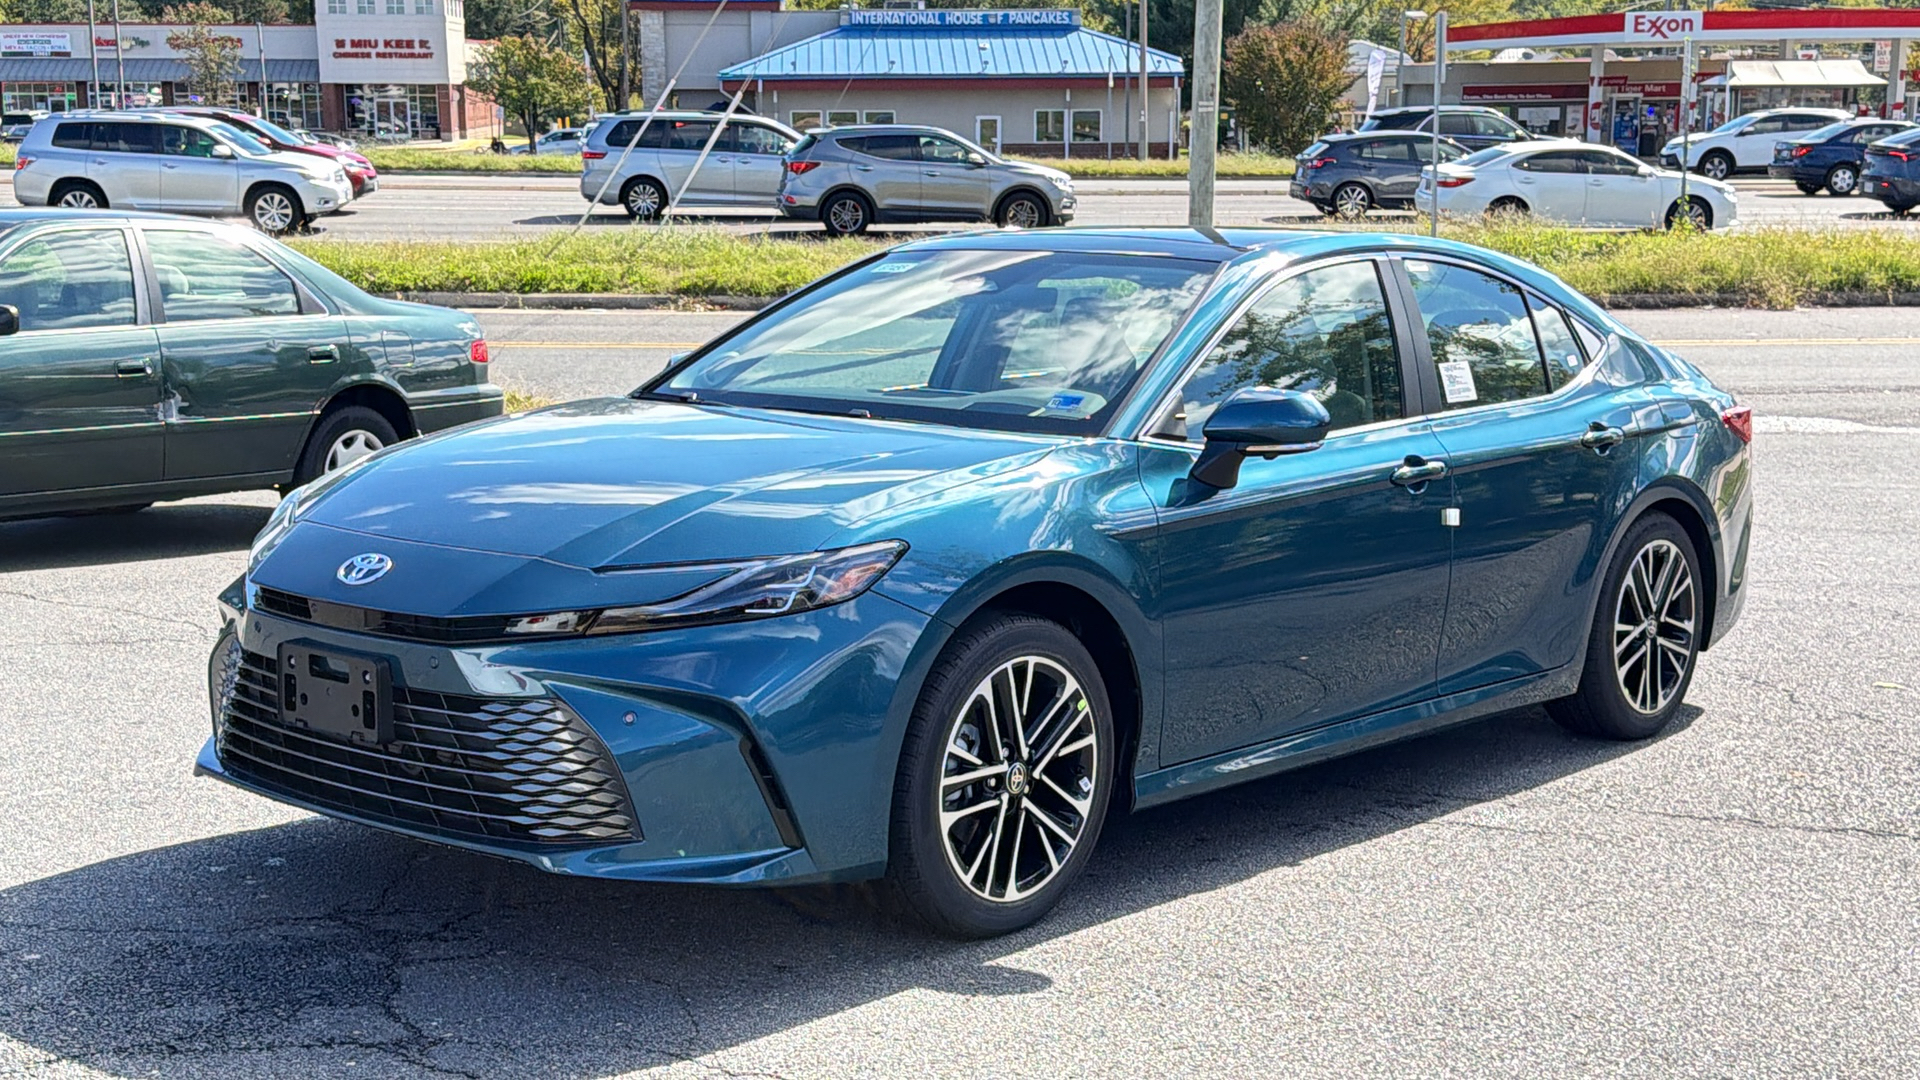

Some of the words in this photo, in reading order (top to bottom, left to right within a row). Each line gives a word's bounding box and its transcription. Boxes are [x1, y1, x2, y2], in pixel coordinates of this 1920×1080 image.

[851, 11, 942, 25] INTERNATIONAL
[945, 11, 984, 25] HOUSE
[1009, 11, 1070, 25] PANCAKES
[1633, 15, 1694, 39] Exxon
[350, 39, 379, 49] MIU
[383, 39, 415, 49] KEE
[332, 51, 372, 59] CHINESE
[375, 51, 434, 59] RESTAURANT
[1644, 84, 1667, 93] Mart
